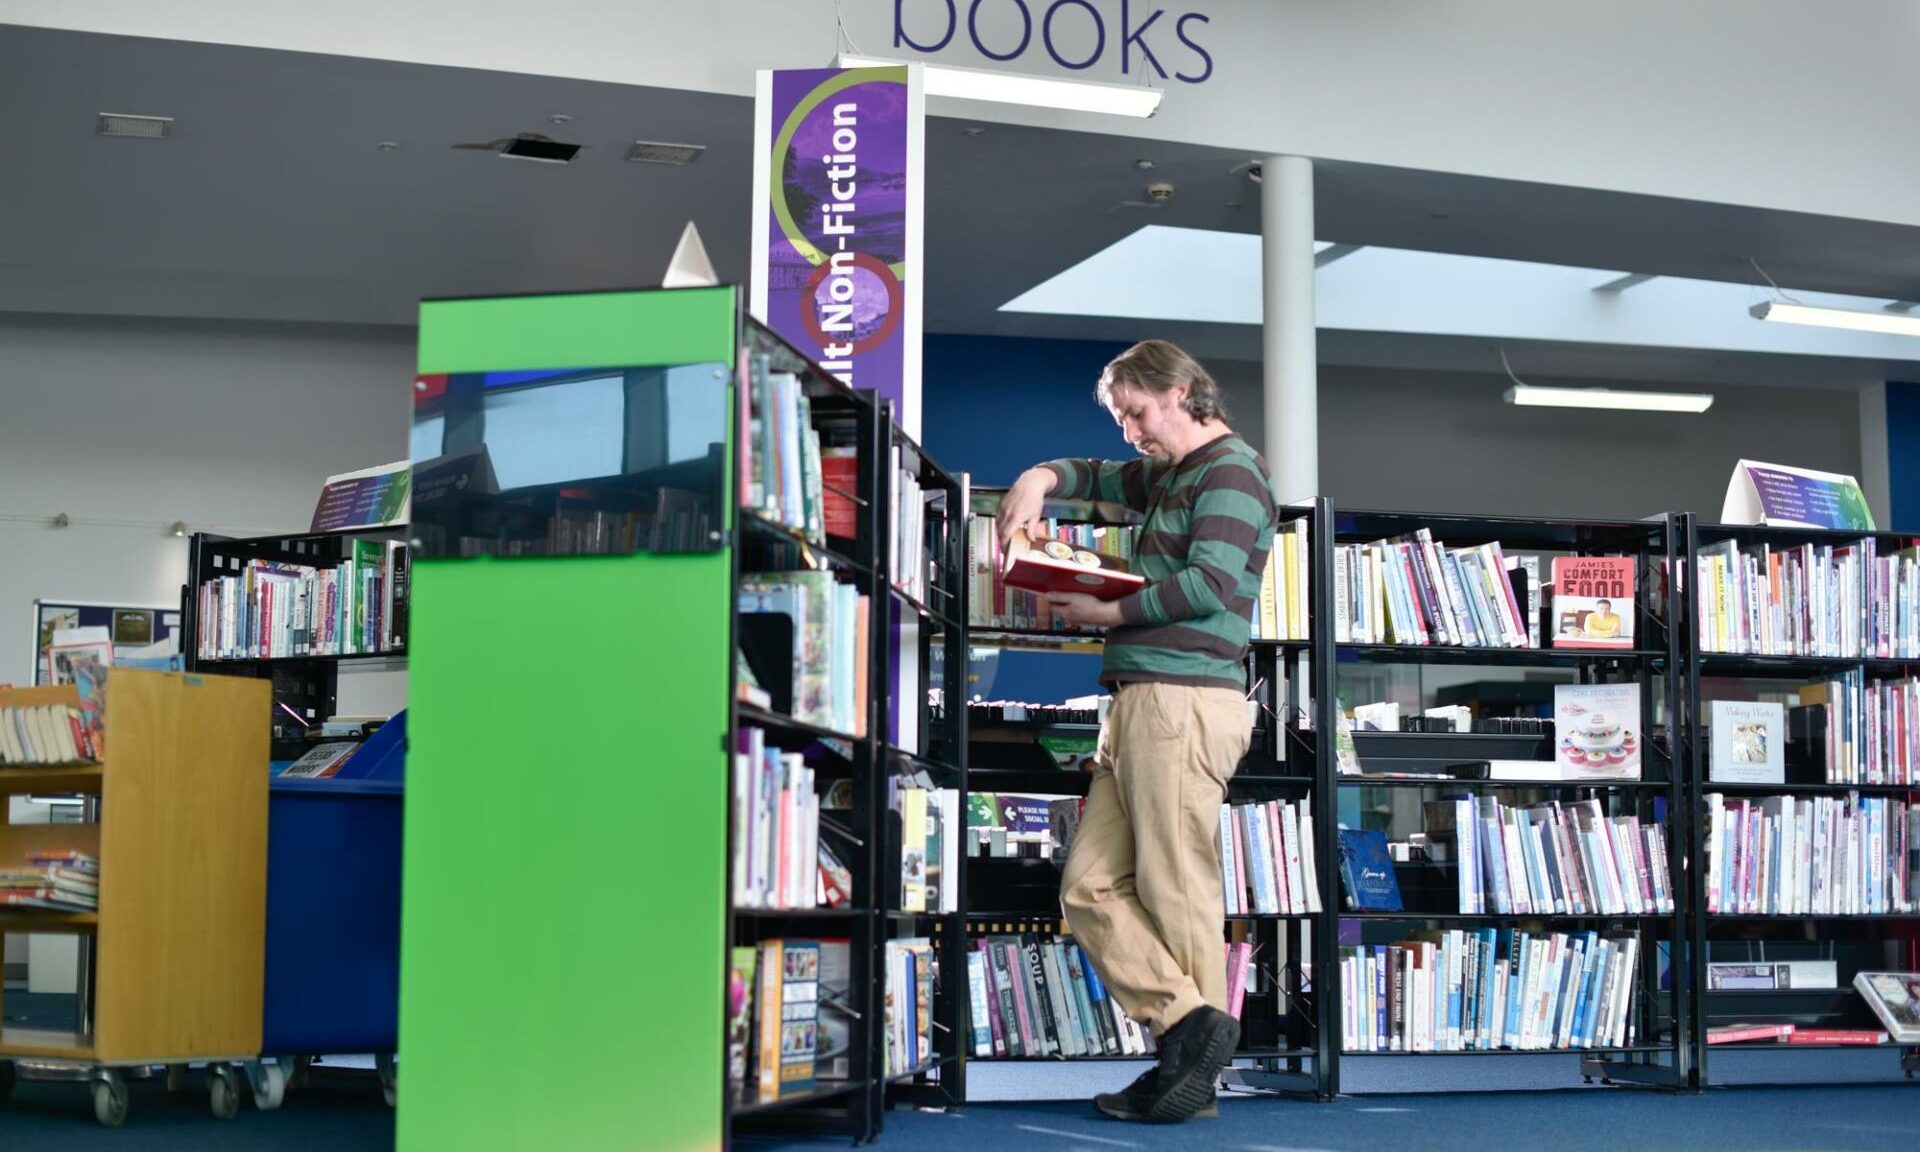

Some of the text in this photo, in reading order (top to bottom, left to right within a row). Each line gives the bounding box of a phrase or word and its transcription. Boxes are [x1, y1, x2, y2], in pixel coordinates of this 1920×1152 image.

[893, 0, 1213, 84] books
[821, 102, 858, 333] Non-Fiction
[1563, 569, 1625, 580] COMFORT
[1563, 580, 1625, 598] FOOD
[1027, 944, 1045, 986] SOUP
